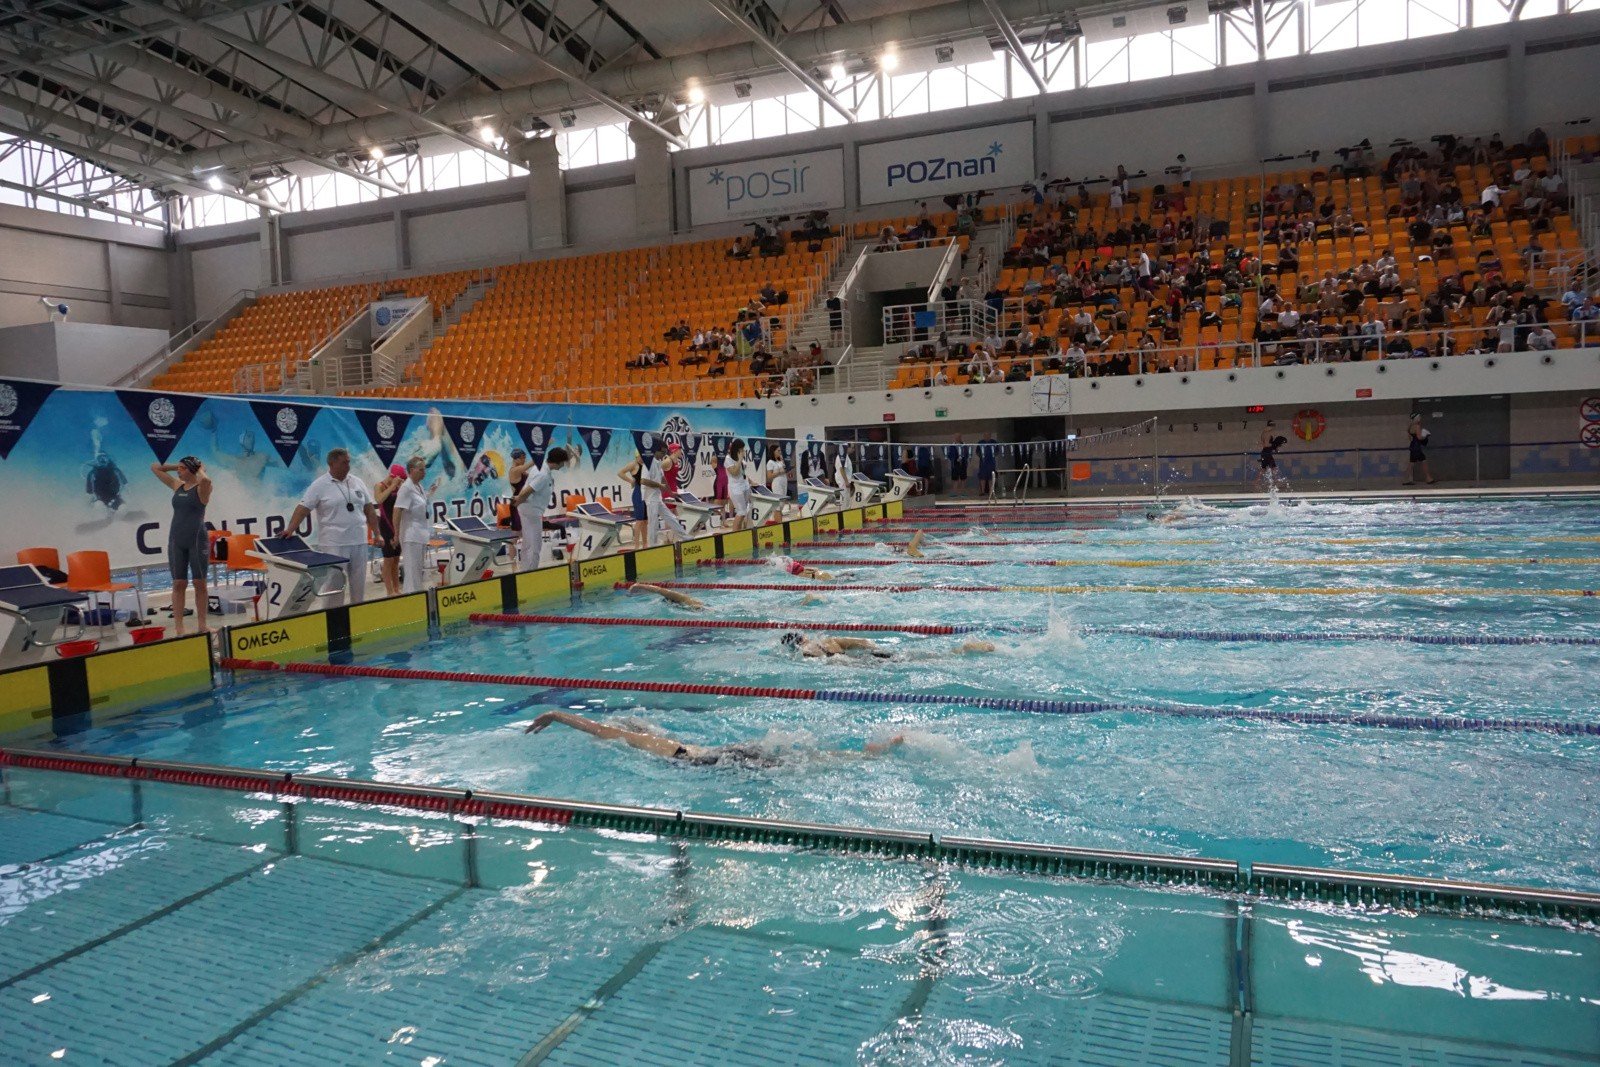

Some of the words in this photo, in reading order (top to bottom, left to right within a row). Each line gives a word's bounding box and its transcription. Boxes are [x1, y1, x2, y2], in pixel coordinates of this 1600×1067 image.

[855, 492, 862, 502] 8
[893, 486, 900, 496] 9
[809, 499, 816, 510] 7
[751, 508, 759, 520] 6
[583, 535, 593, 551] 4
[683, 545, 702, 556] OMEGA
[455, 553, 466, 572] 3
[582, 564, 608, 578] OMEGA
[269, 582, 282, 606] 2
[441, 590, 478, 608] OMEGA
[237, 628, 291, 651] OMEGA
